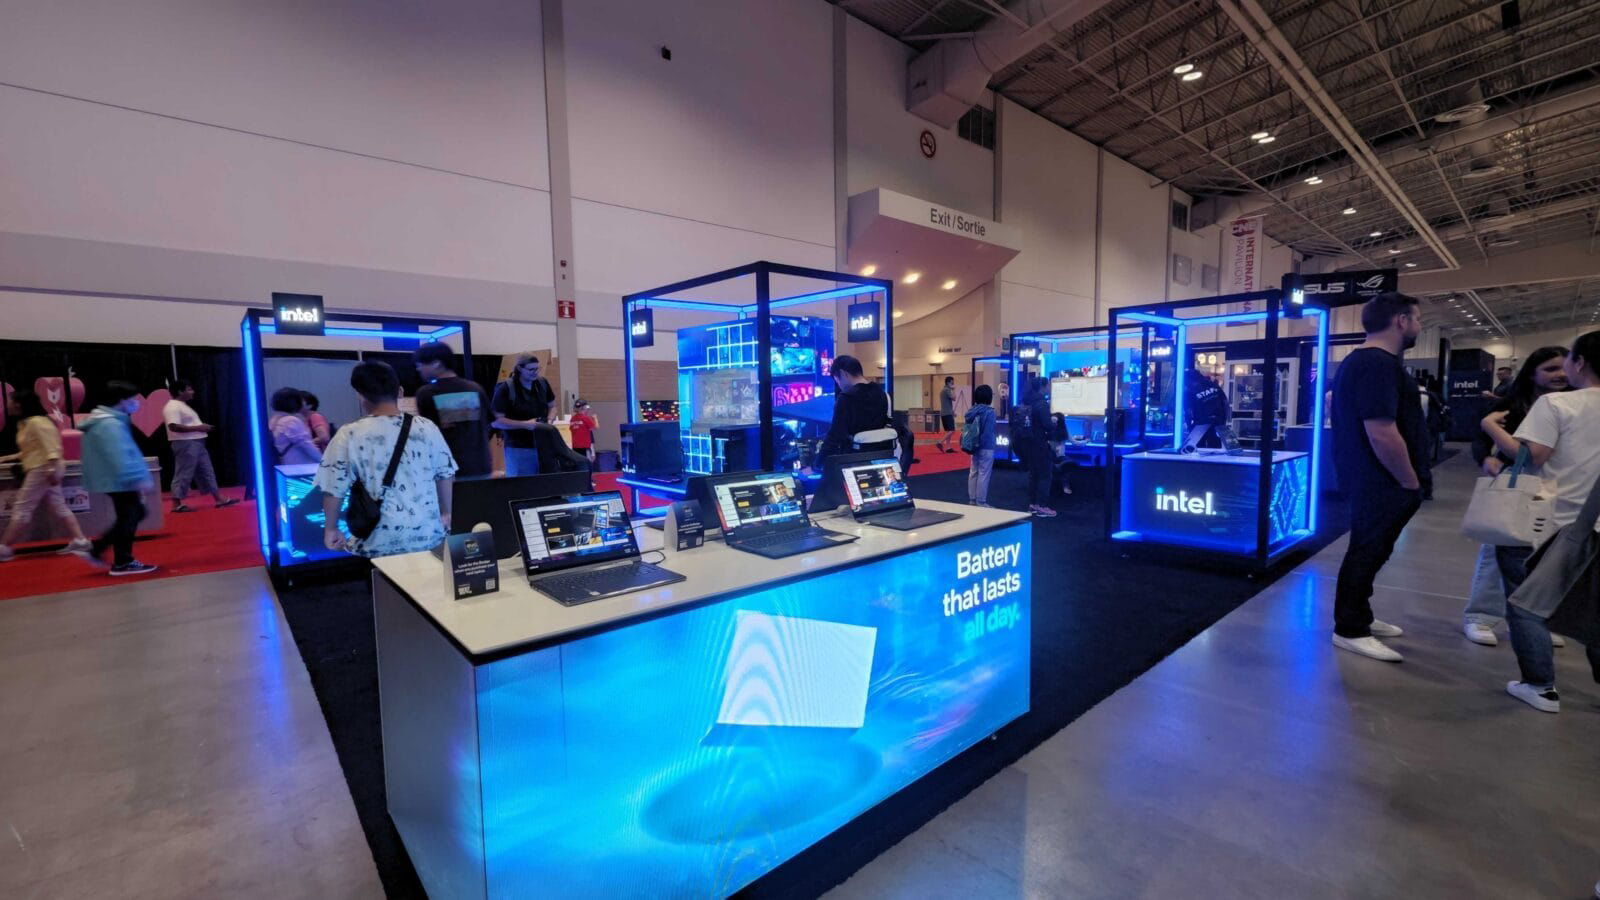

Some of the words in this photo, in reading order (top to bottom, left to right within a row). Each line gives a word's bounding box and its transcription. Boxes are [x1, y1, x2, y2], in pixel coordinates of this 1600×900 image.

[1233, 238, 1245, 287] PAVILION
[1243, 236, 1255, 313] INTERNATINA
[1303, 281, 1346, 295] SUS
[280, 305, 319, 322] intel
[851, 313, 873, 330] intel
[1454, 380, 1479, 389] intel
[956, 541, 1021, 580] Battery
[942, 582, 980, 617] that
[982, 570, 1021, 603] lasts
[962, 609, 985, 641] all
